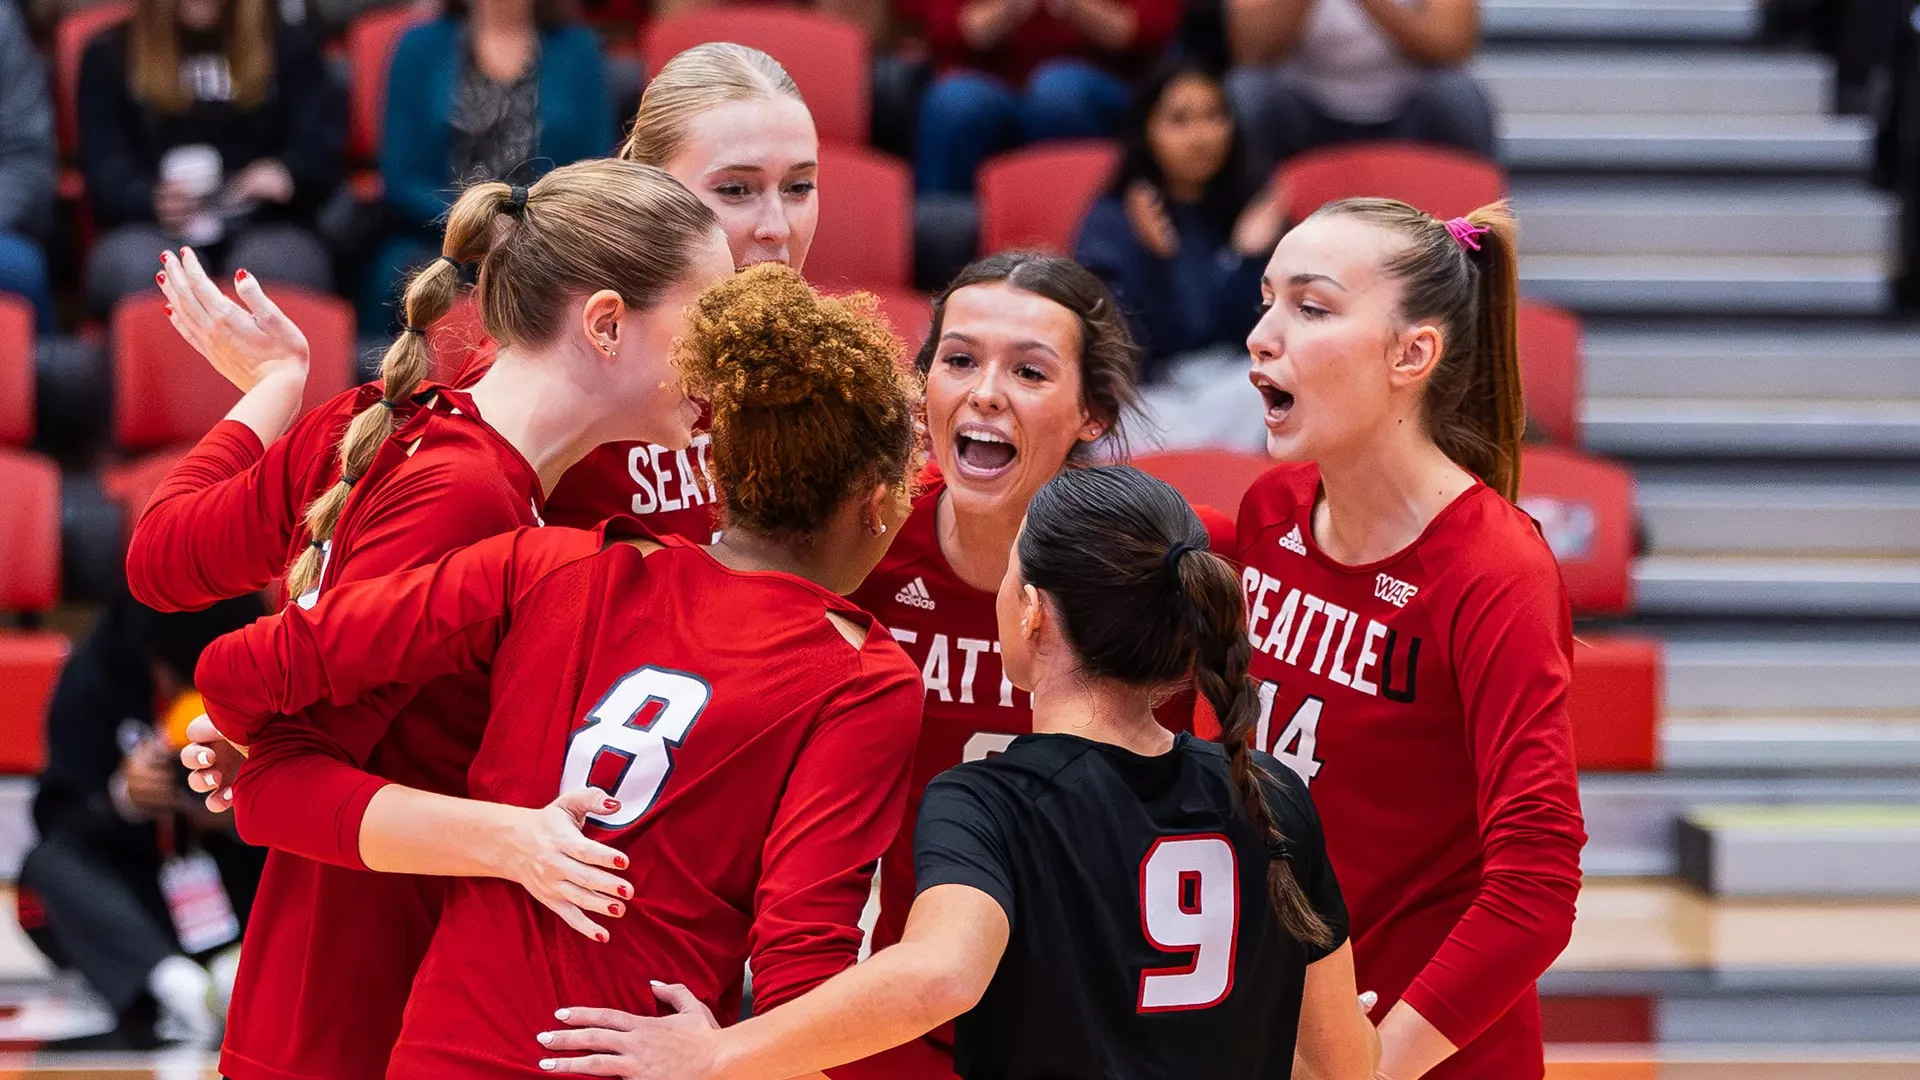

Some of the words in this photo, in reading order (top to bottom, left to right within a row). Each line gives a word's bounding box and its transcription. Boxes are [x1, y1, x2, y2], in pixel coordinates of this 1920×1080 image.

[895, 592, 936, 610] adidas
[1374, 573, 1419, 608] WAC
[559, 664, 712, 831] 8
[1137, 833, 1240, 1014] 9
